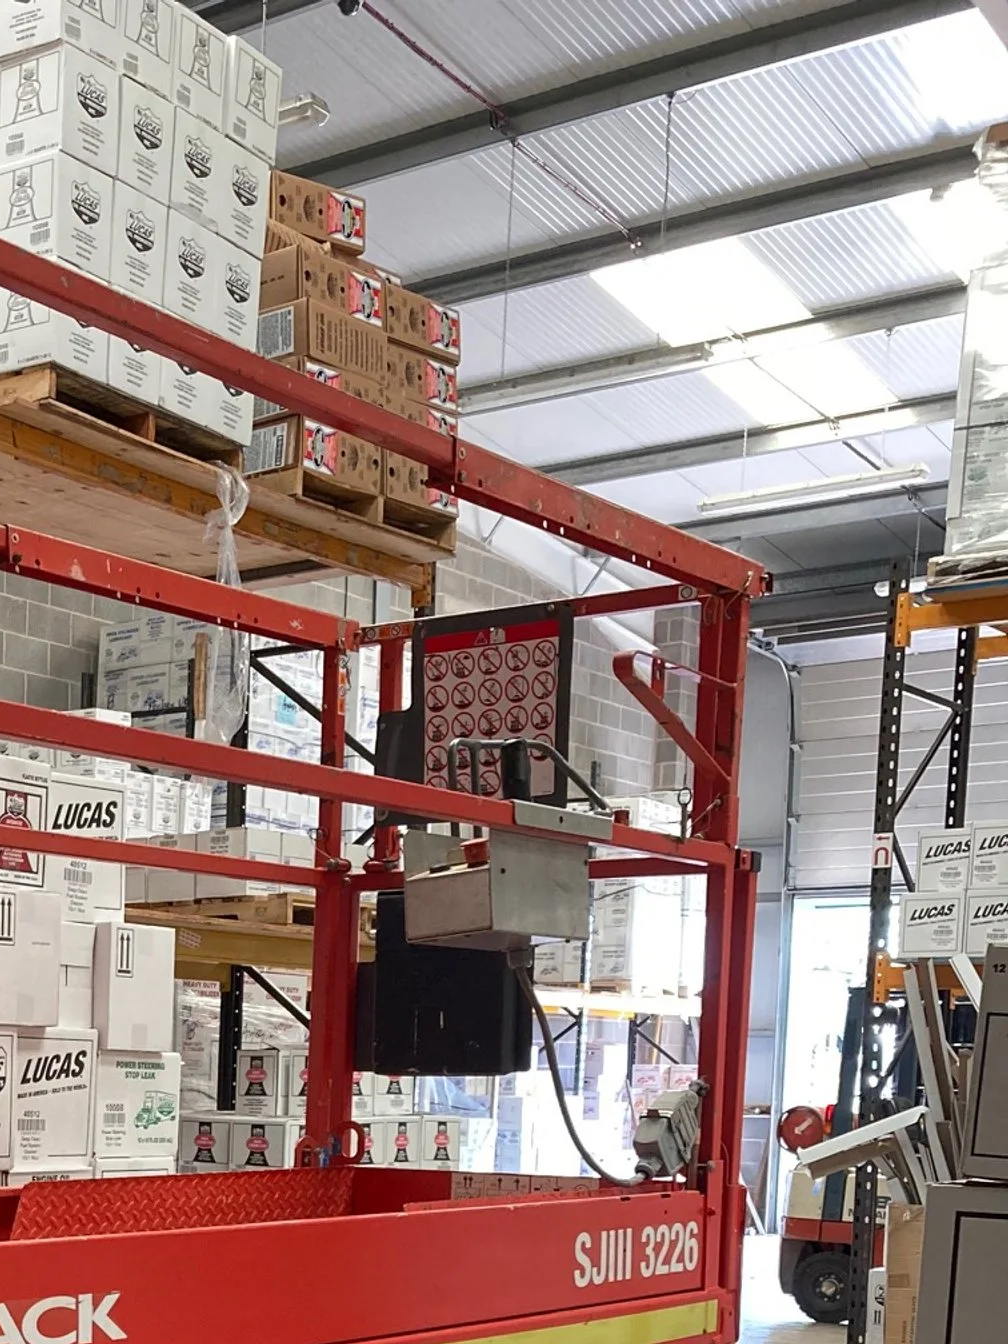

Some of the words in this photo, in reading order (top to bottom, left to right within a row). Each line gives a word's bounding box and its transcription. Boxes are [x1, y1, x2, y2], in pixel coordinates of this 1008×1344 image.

[80, 85, 105, 103] LUCAS
[137, 117, 161, 136] LUCAS
[188, 147, 210, 164] LUCAS
[235, 175, 256, 193] LUCAS
[75, 191, 98, 211] LUCAS
[129, 221, 153, 239] LUCAS
[182, 248, 204, 265] LUCAS
[228, 274, 250, 291] LUCAS
[52, 801, 118, 830] LUCAS
[925, 839, 971, 858] LUCAS
[979, 834, 1008, 851] LUC
[910, 904, 955, 920] LUCAS
[973, 903, 1008, 919] LUCA
[20, 1050, 87, 1085] LUCAS
[116, 1061, 136, 1069] POWER
[138, 1061, 165, 1070] STEERING
[125, 1071, 140, 1079] STOP
[141, 1072, 155, 1080] LEAK
[574, 1228, 633, 1288] SJIII
[640, 1221, 699, 1279] 3226
